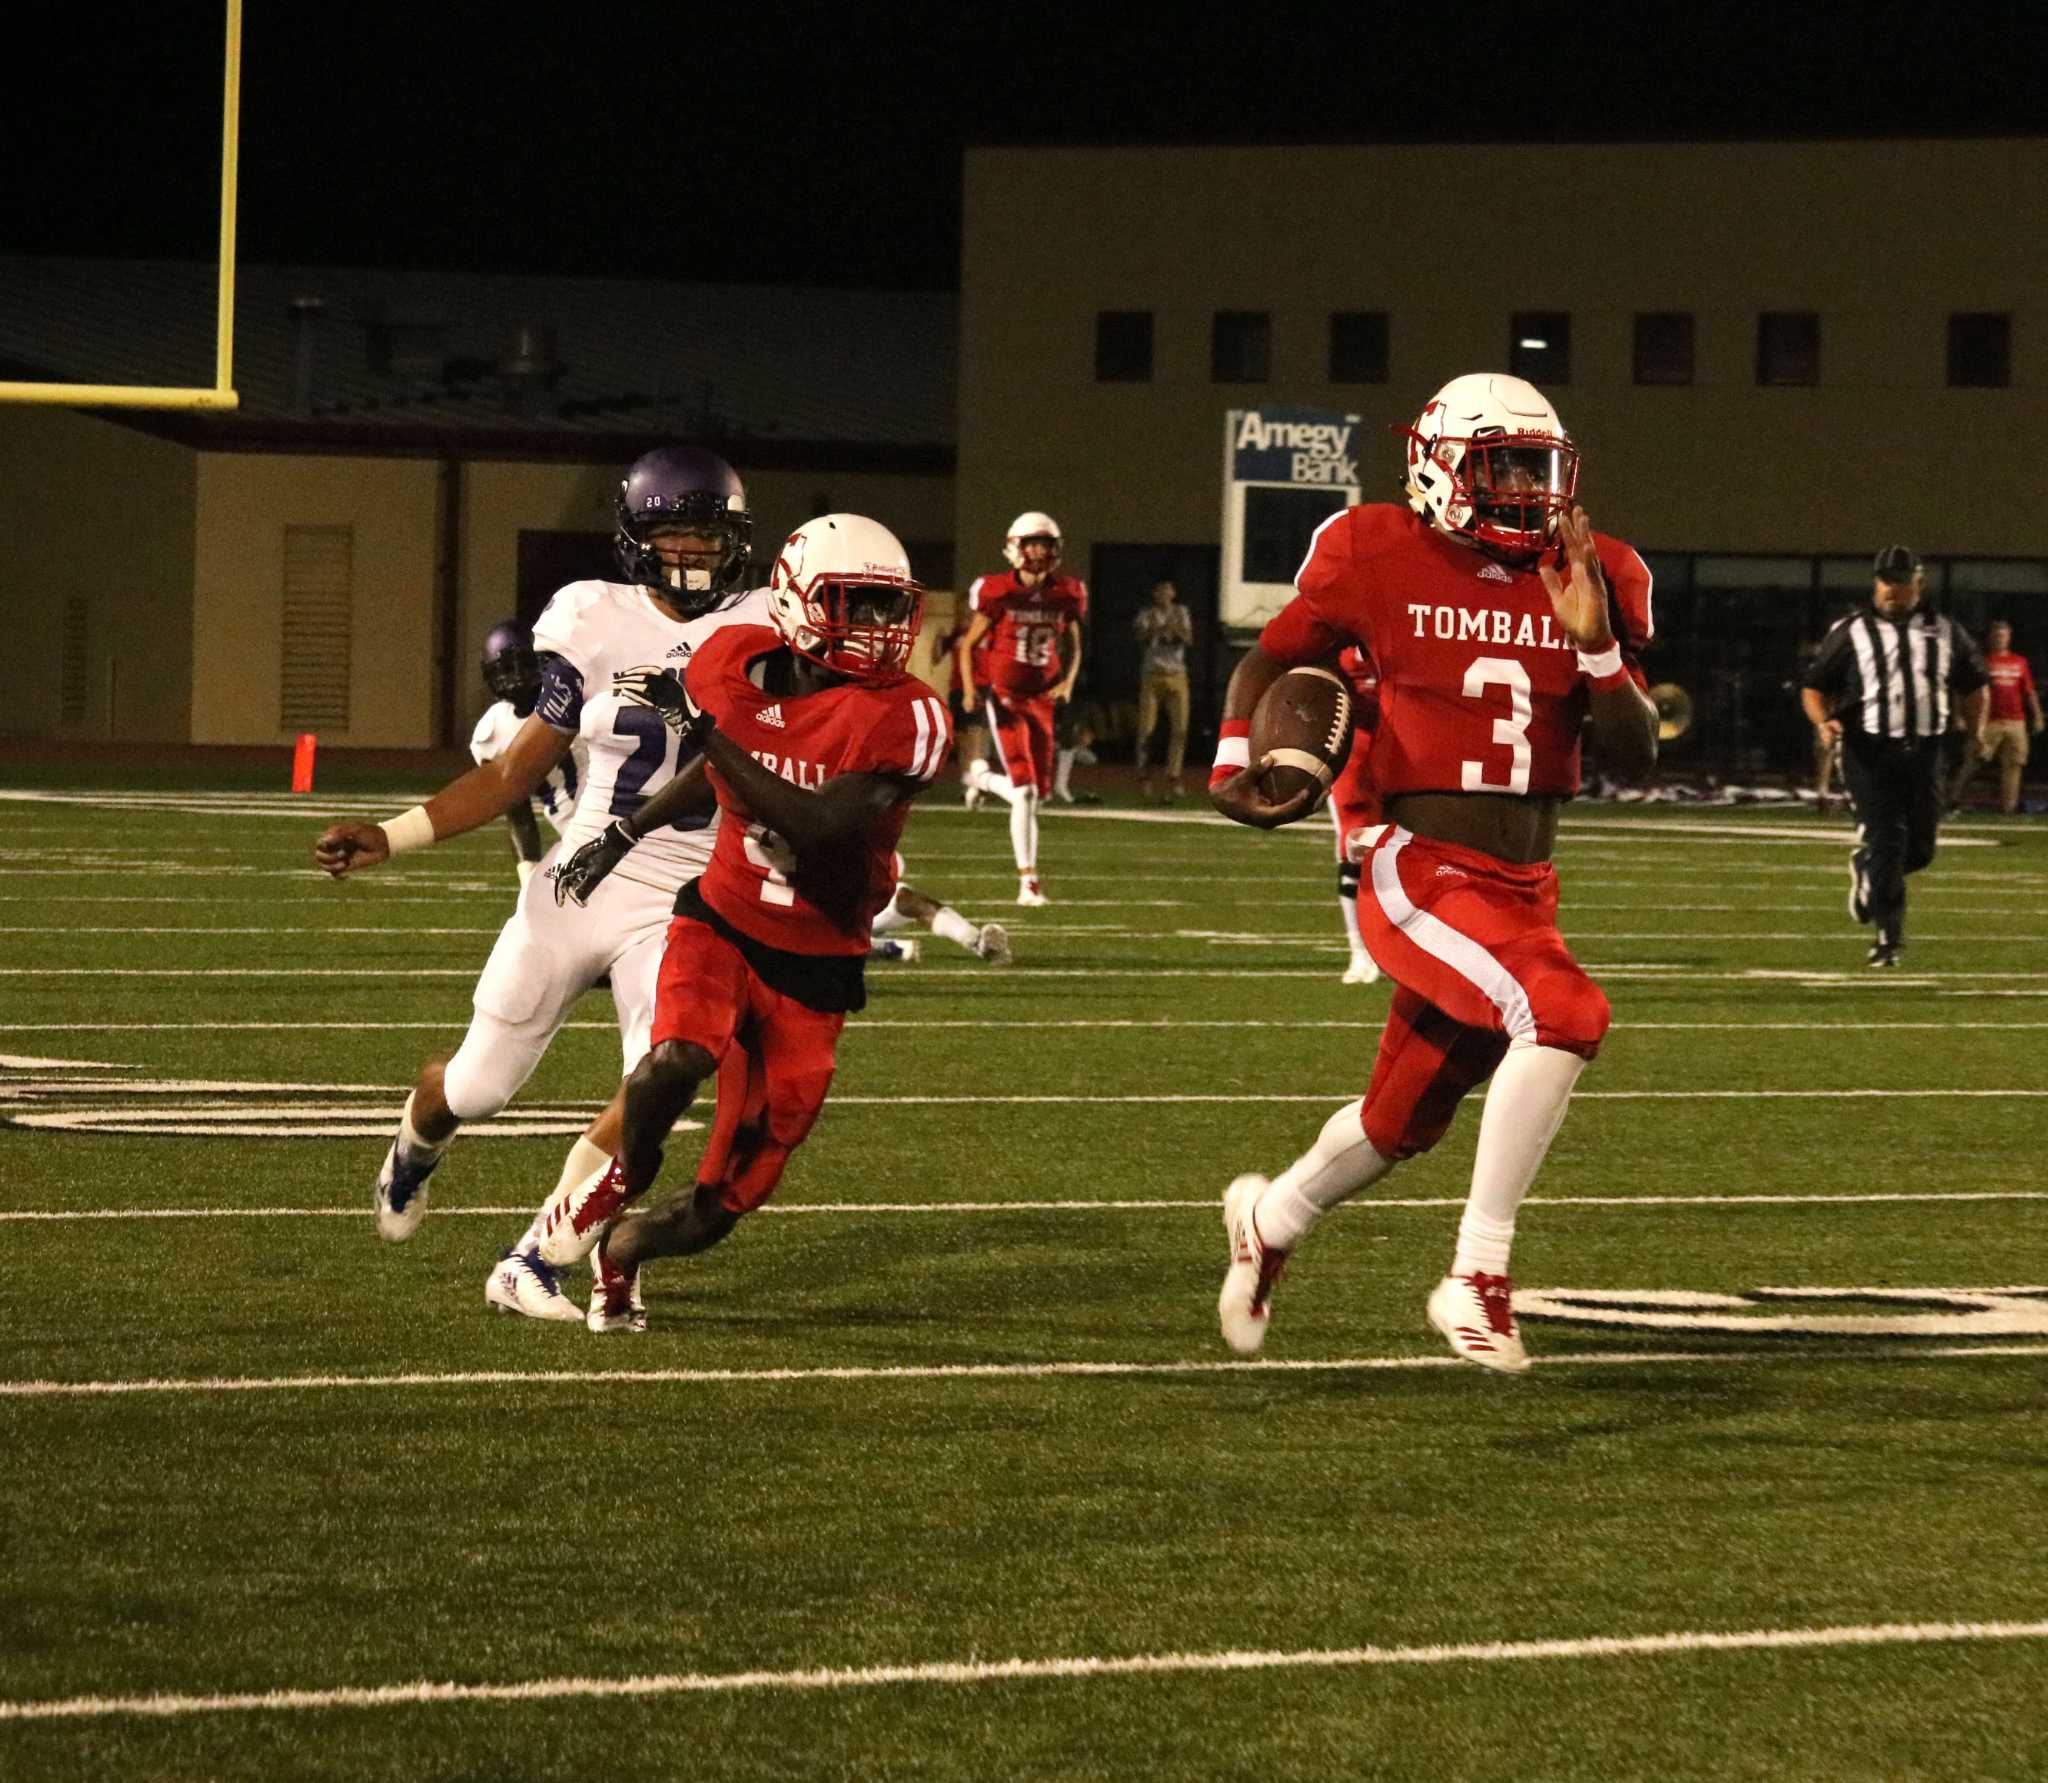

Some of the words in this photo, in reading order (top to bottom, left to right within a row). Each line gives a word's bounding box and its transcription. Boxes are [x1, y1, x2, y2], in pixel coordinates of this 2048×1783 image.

[1237, 412, 1350, 459] Amegy
[1292, 452, 1358, 484] Bank
[646, 496, 661, 508] 20
[1408, 604, 1570, 650] TOMBAL
[1461, 657, 1533, 795] 3
